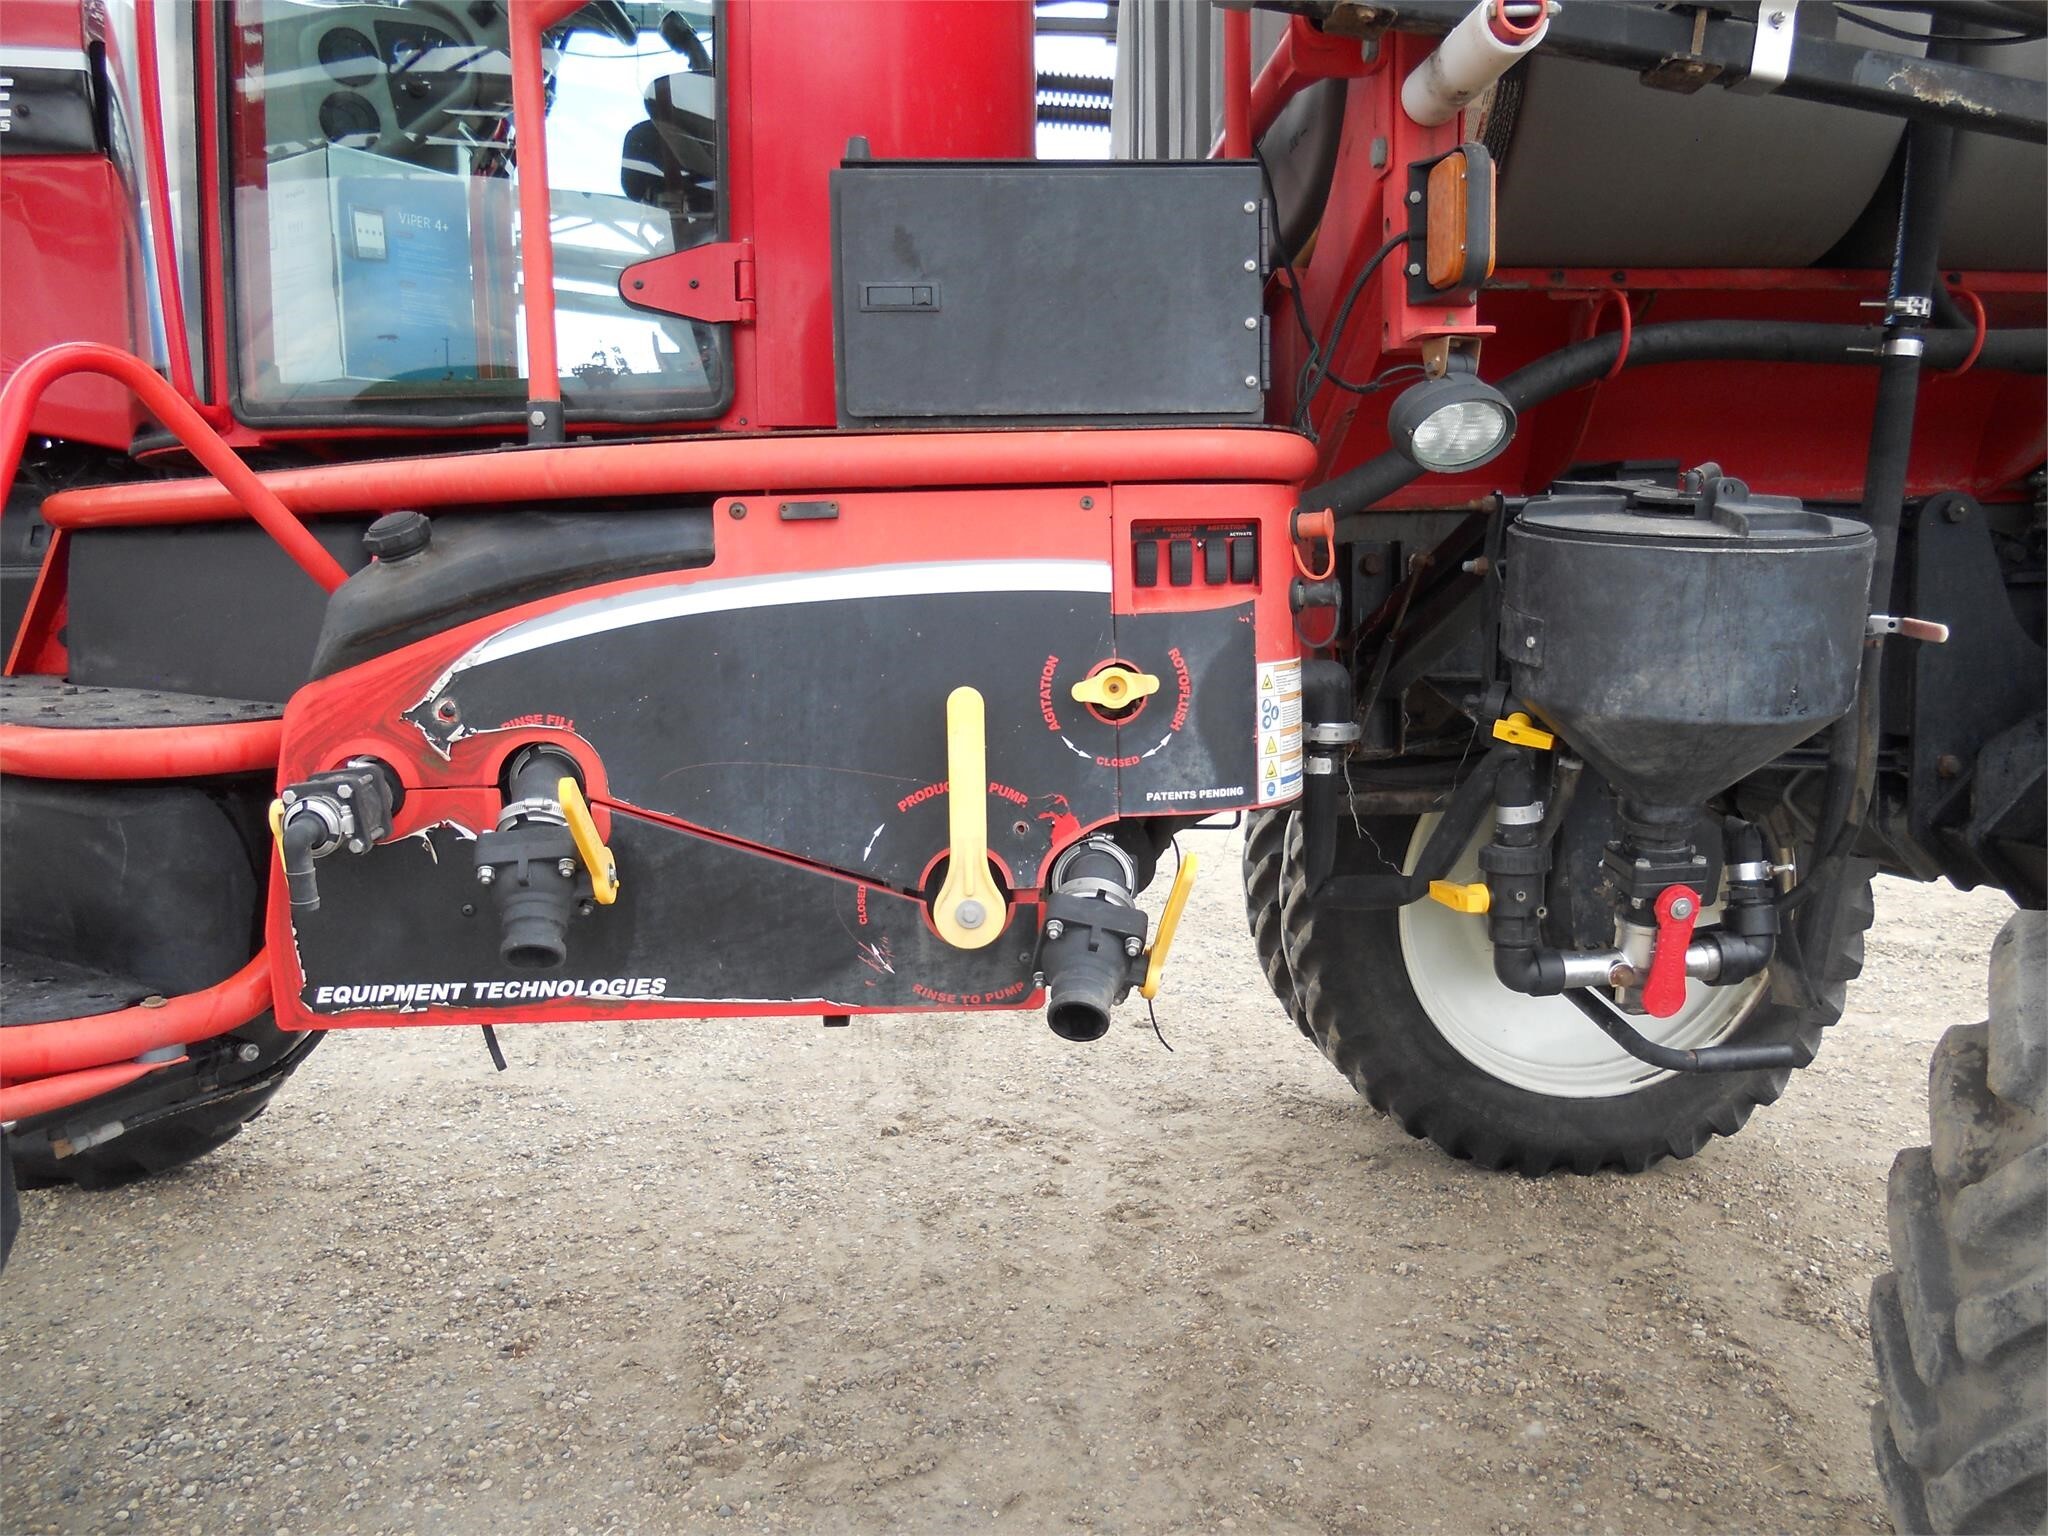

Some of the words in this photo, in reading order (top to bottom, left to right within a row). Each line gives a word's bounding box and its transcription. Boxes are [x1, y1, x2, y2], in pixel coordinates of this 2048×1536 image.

[398, 212, 431, 229] VIPER
[434, 219, 449, 232] 4+
[1040, 655, 1061, 731] AGITATION
[1168, 647, 1192, 732] ROTOFLUSH
[546, 714, 576, 731] FILL
[1096, 756, 1140, 767] CLOSED
[897, 781, 950, 812] PRODUC
[988, 782, 1029, 806] PUMP
[1146, 790, 1197, 801] PATENTS
[1199, 786, 1244, 799] PENDING
[857, 885, 867, 925] CLOSED
[316, 983, 466, 1004] EQUIPMENT
[474, 978, 667, 999] TECHNOLOGIES
[912, 983, 957, 1003] RINSE
[961, 994, 981, 1004] TO
[985, 981, 1025, 1002] PUMP
